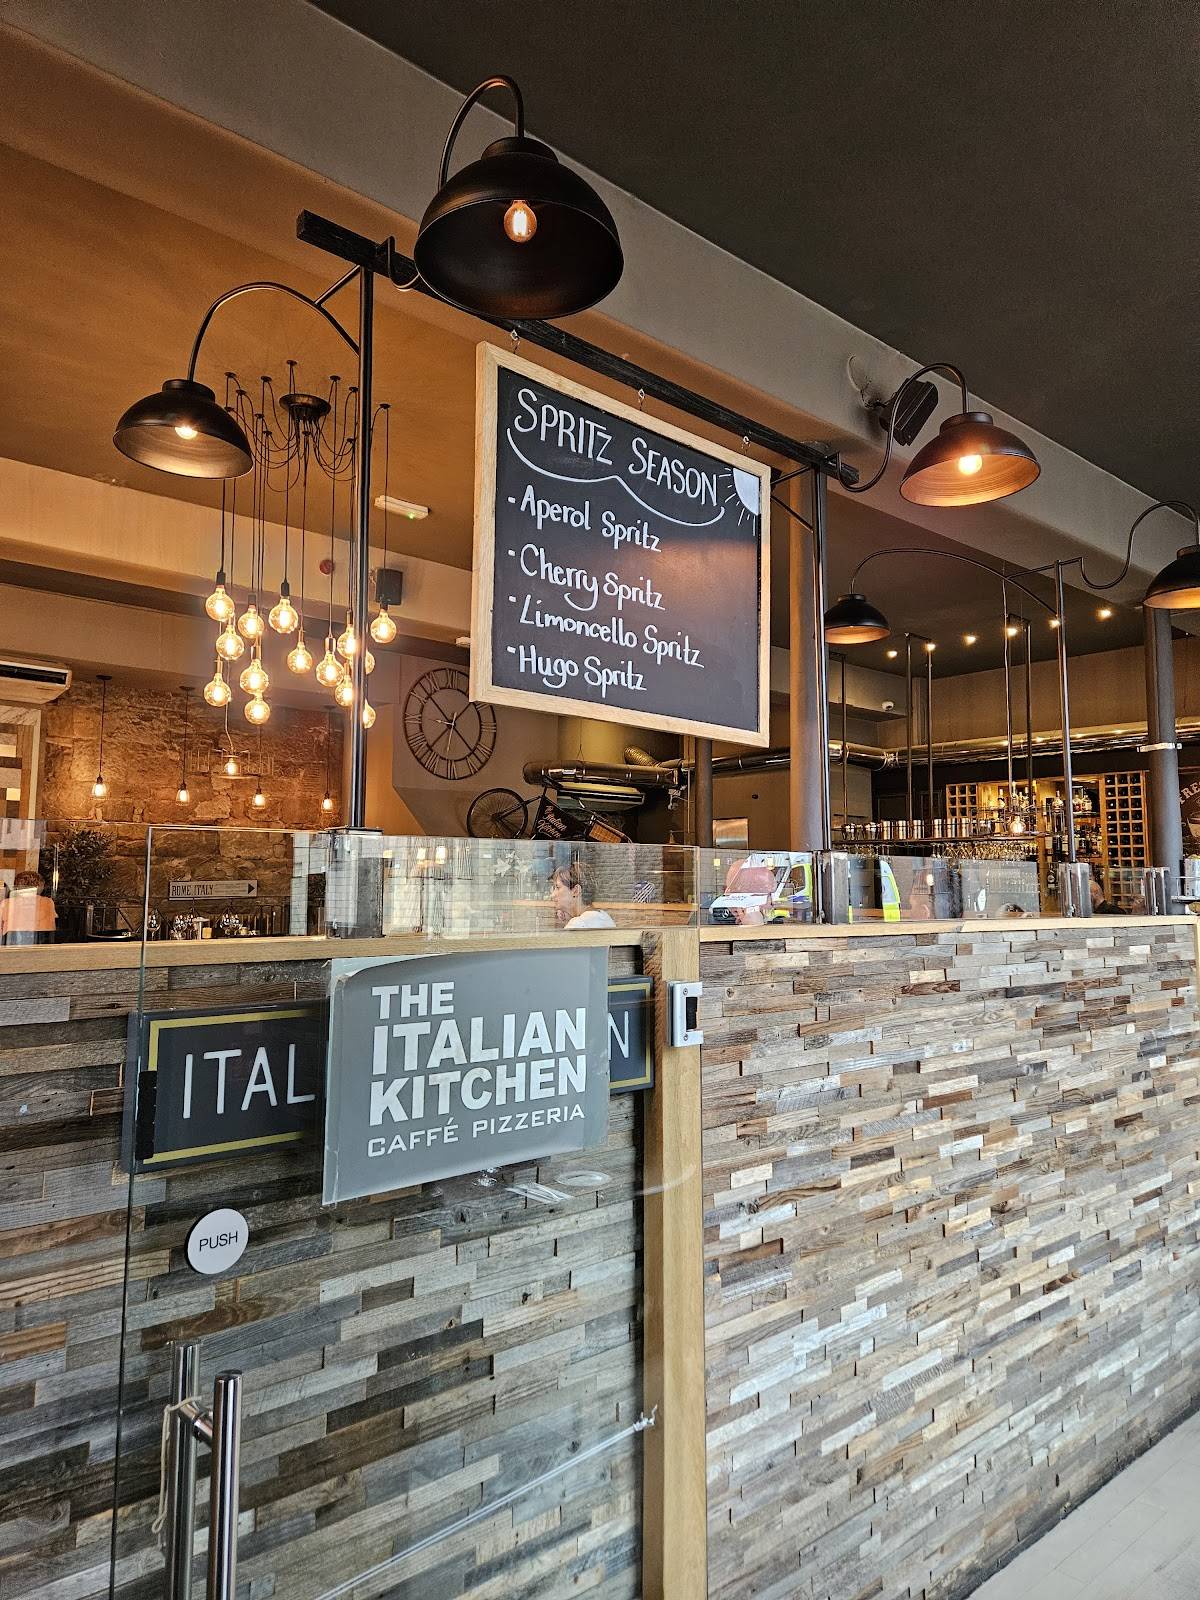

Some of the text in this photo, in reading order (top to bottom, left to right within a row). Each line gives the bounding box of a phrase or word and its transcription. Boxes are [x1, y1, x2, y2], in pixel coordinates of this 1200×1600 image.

[514, 388, 718, 507] SPRITZ SEASON
[520, 484, 591, 530] Aperol
[601, 511, 662, 553] Spritz
[520, 543, 599, 611] Cherry
[602, 572, 666, 611] Spritz
[519, 594, 638, 648] Limoncello
[642, 624, 705, 669] Spritz
[519, 644, 580, 689] Hugo
[583, 655, 648, 698] Spritz
[371, 981, 455, 1020] THE
[372, 1007, 587, 1075] ITALIAN
[369, 1054, 587, 1126] KITCHEN
[367, 1103, 585, 1158] CAFFÉ PIZZERIA
[199, 1230, 239, 1252] PUSH
